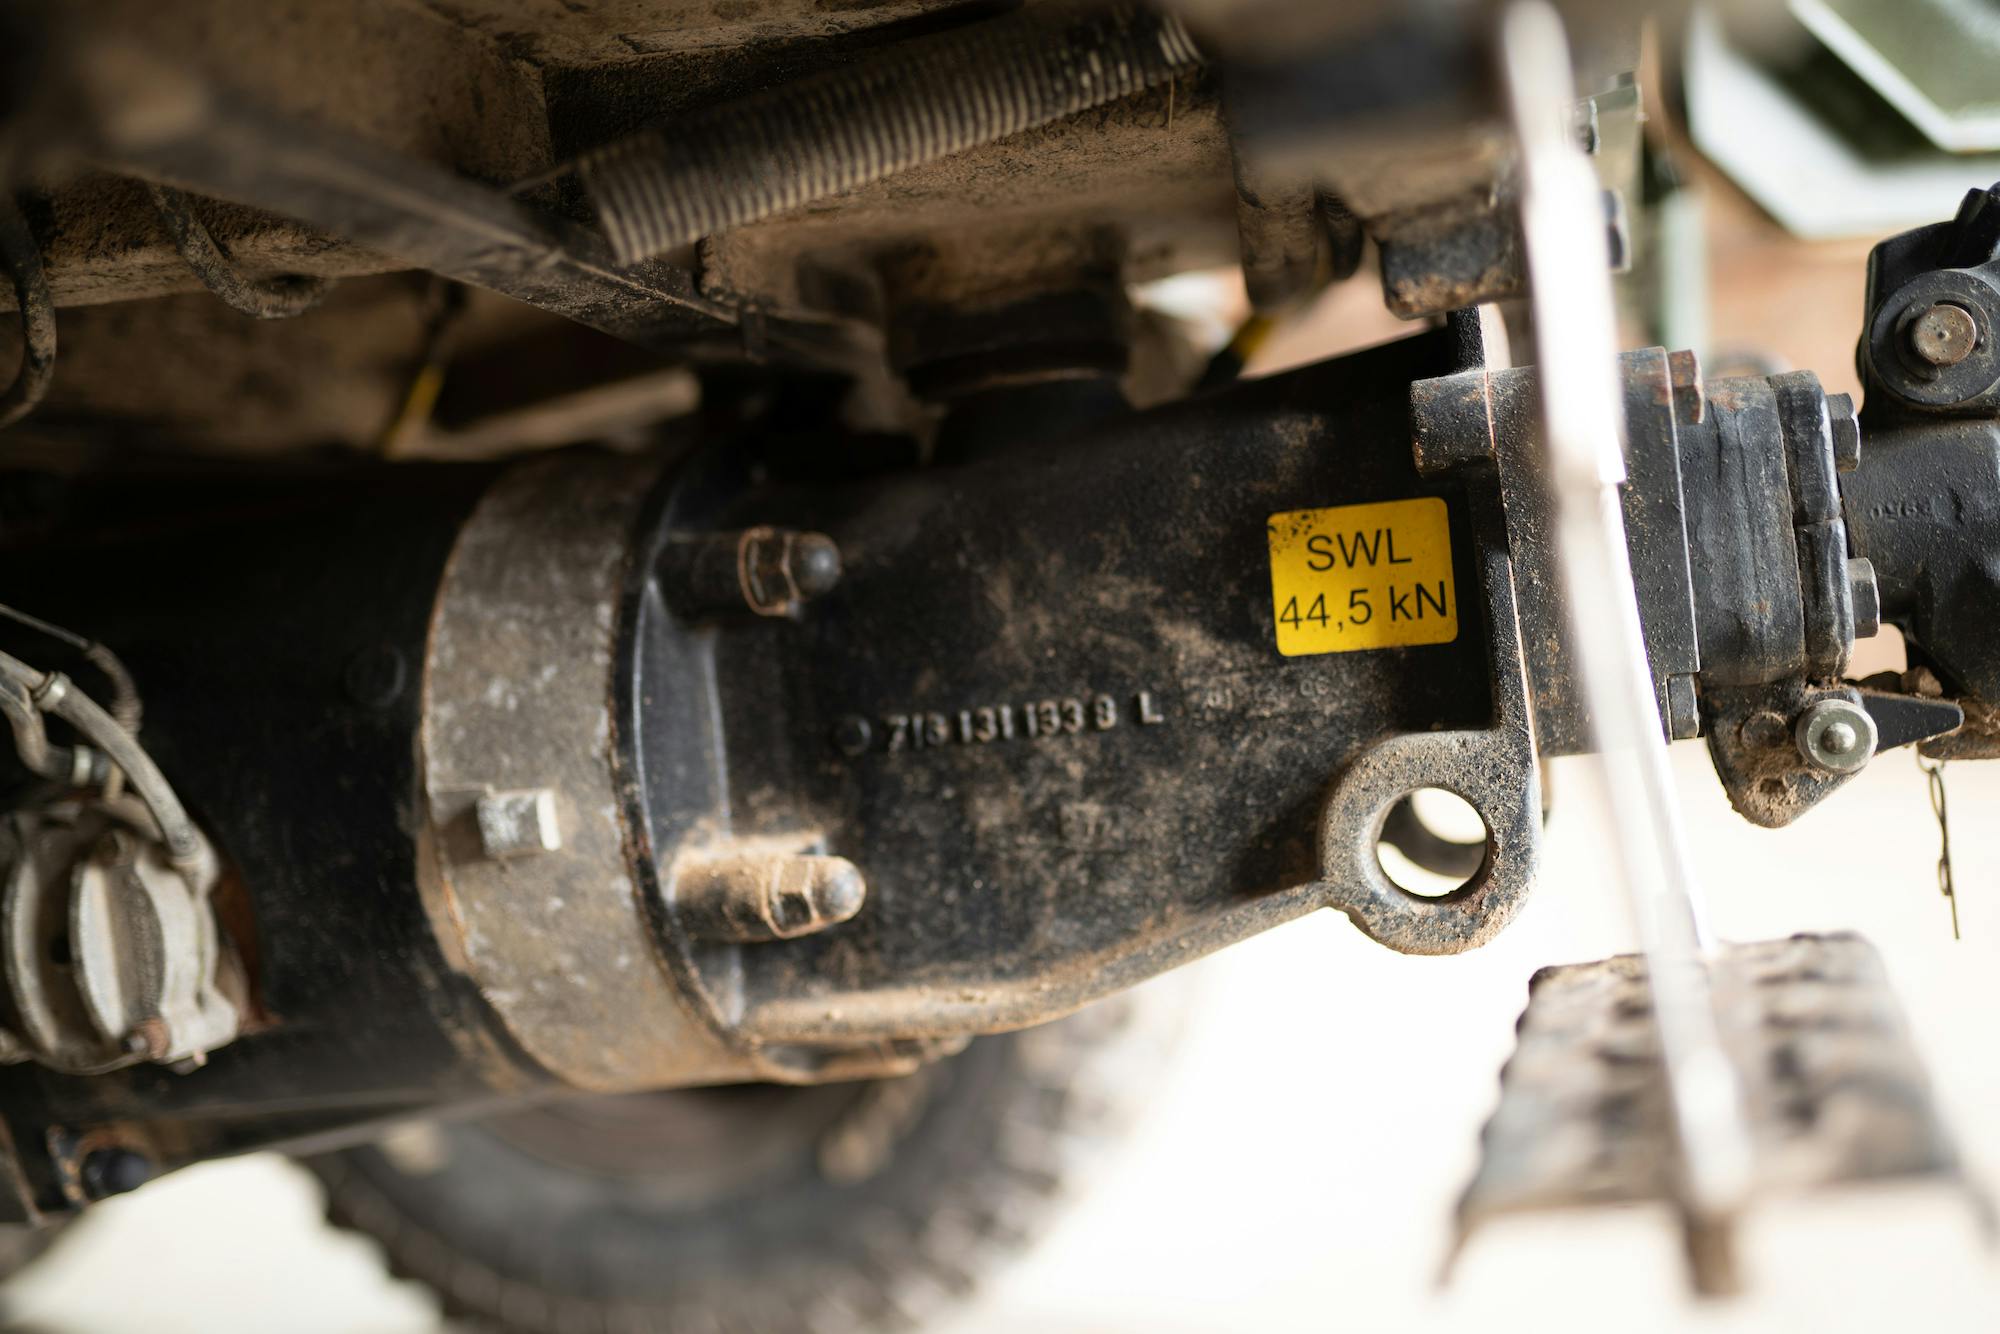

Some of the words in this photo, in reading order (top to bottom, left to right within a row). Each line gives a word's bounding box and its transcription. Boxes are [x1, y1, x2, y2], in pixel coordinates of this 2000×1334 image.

[1306, 528, 1412, 572] SWL
[1279, 588, 1372, 634] 44,5
[1389, 581, 1447, 622] kN
[1138, 691, 1165, 725] L
